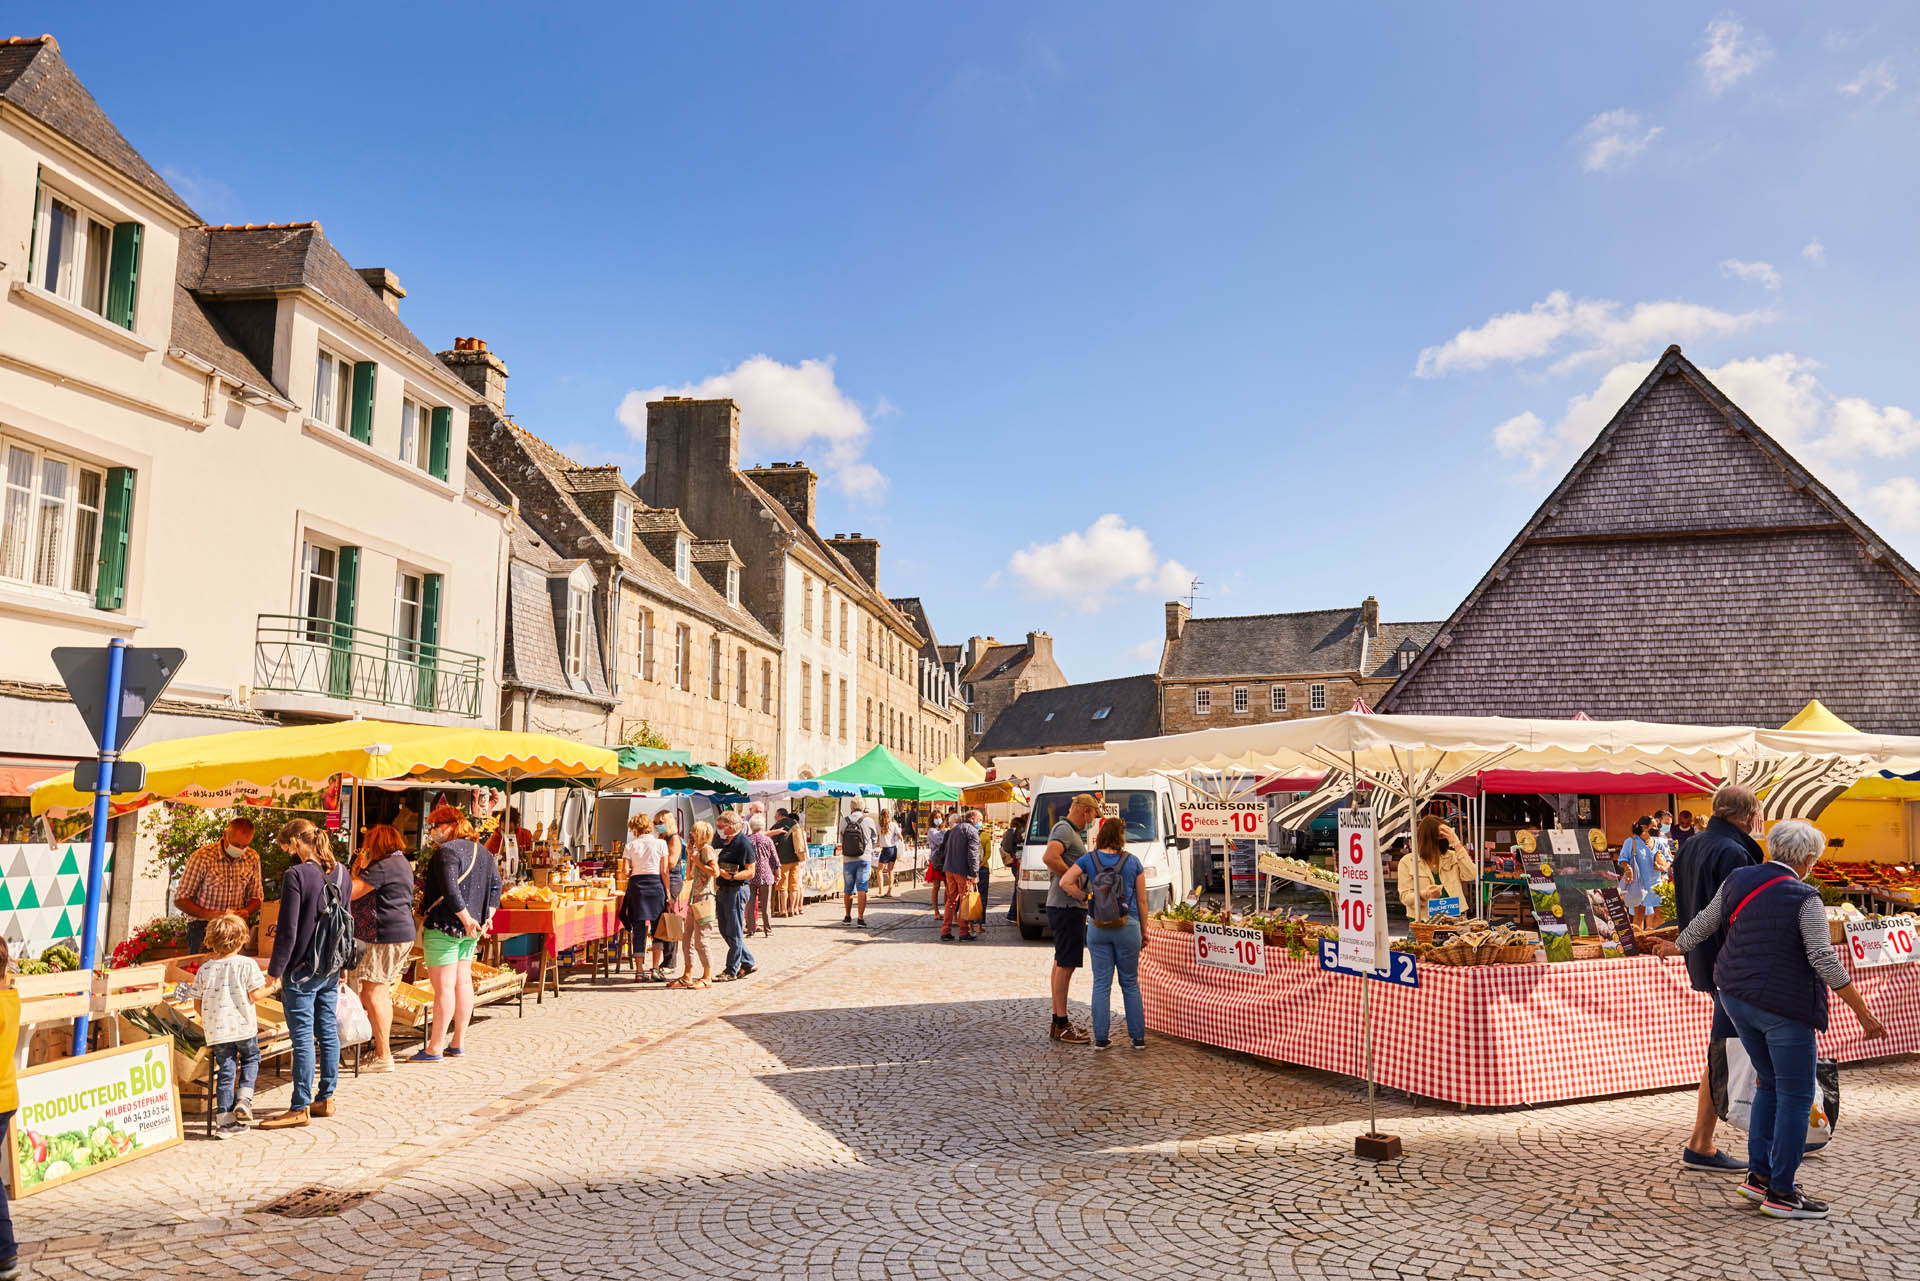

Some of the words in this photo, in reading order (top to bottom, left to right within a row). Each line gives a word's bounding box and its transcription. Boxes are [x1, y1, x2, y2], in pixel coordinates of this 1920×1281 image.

[1179, 802, 1265, 811] SAUCISSONS
[1181, 812, 1194, 833] 6
[1194, 815, 1219, 826] Pièces
[1339, 812, 1372, 829] SAUCISSONS
[1350, 832, 1363, 865] 6
[1342, 866, 1369, 881] Pièces
[1195, 924, 1262, 940] SAUCISSONS
[1846, 918, 1912, 933] SAUCISSONS
[1198, 935, 1209, 958] 6
[1208, 941, 1227, 954] Pièces
[1852, 935, 1865, 960] 6
[1398, 955, 1416, 985] 2
[22, 1080, 128, 1127] PRODUCTEUR
[123, 1114, 132, 1124] 06
[133, 1112, 142, 1122] 34
[143, 1109, 151, 1120] 33
[160, 1104, 170, 1115] 54
[138, 1116, 171, 1132] Plouescat
